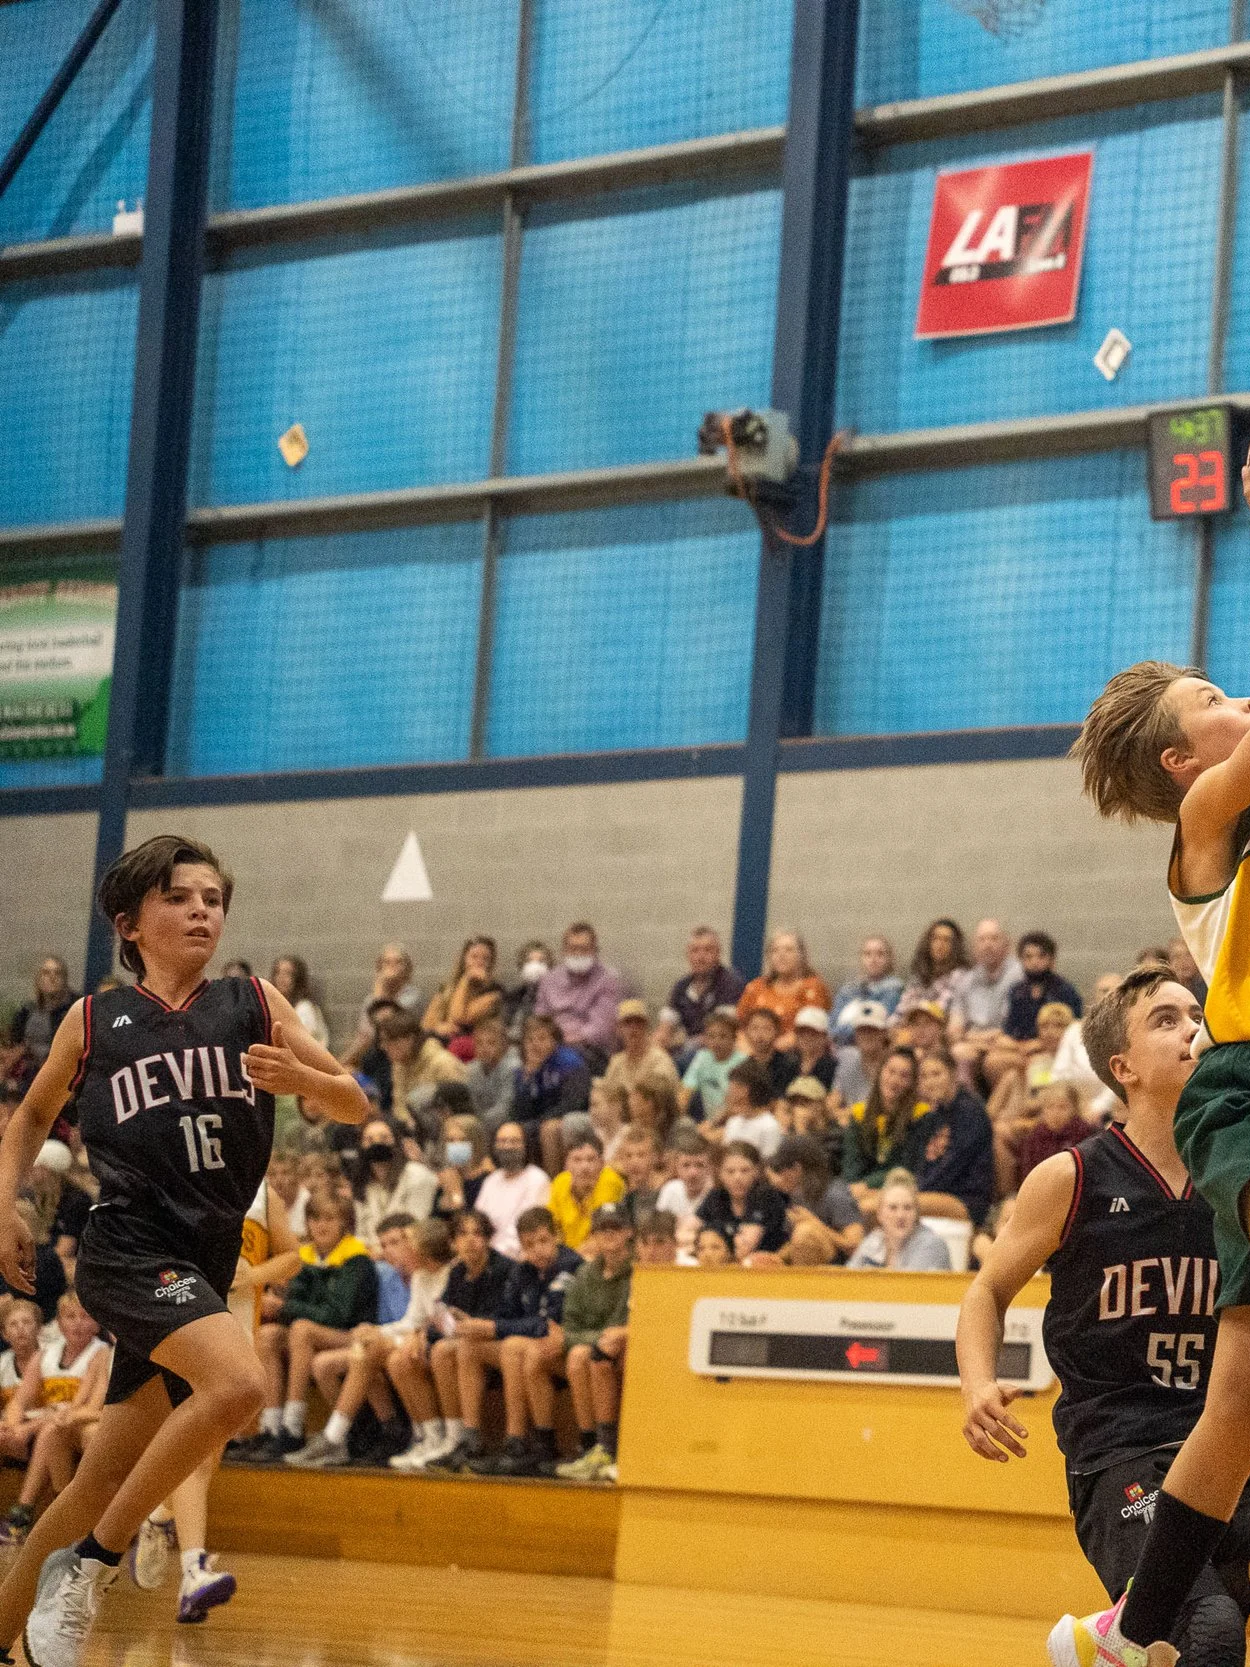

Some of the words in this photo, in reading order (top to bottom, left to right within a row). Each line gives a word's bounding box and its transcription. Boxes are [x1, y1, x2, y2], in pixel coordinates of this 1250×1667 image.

[1169, 450, 1226, 514] 23
[179, 1114, 226, 1174] 16
[155, 1276, 197, 1298] Choices
[1146, 1332, 1205, 1390] 55
